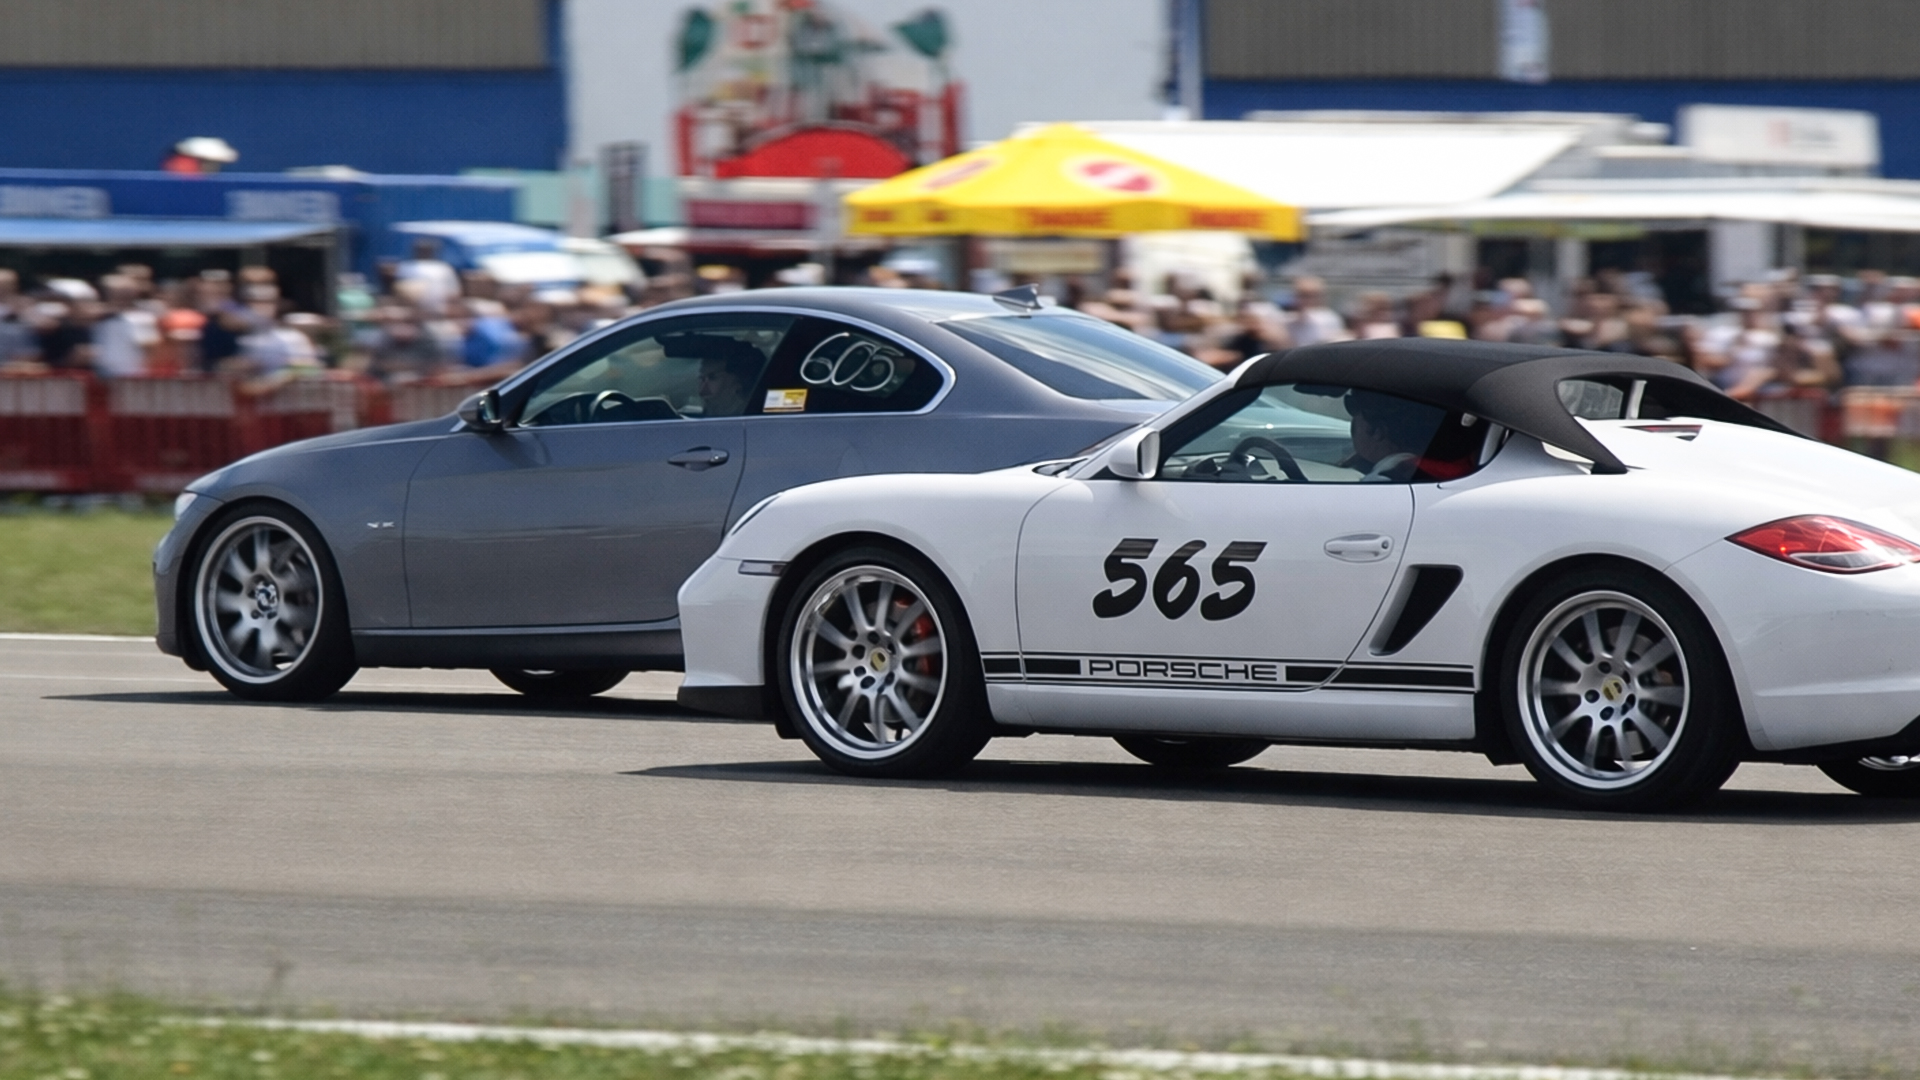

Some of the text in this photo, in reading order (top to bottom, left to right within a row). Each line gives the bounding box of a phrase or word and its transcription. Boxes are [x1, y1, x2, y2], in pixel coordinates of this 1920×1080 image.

[800, 332, 904, 392] 605
[1092, 538, 1267, 621] 565
[1088, 659, 1277, 682] PORSCHE
